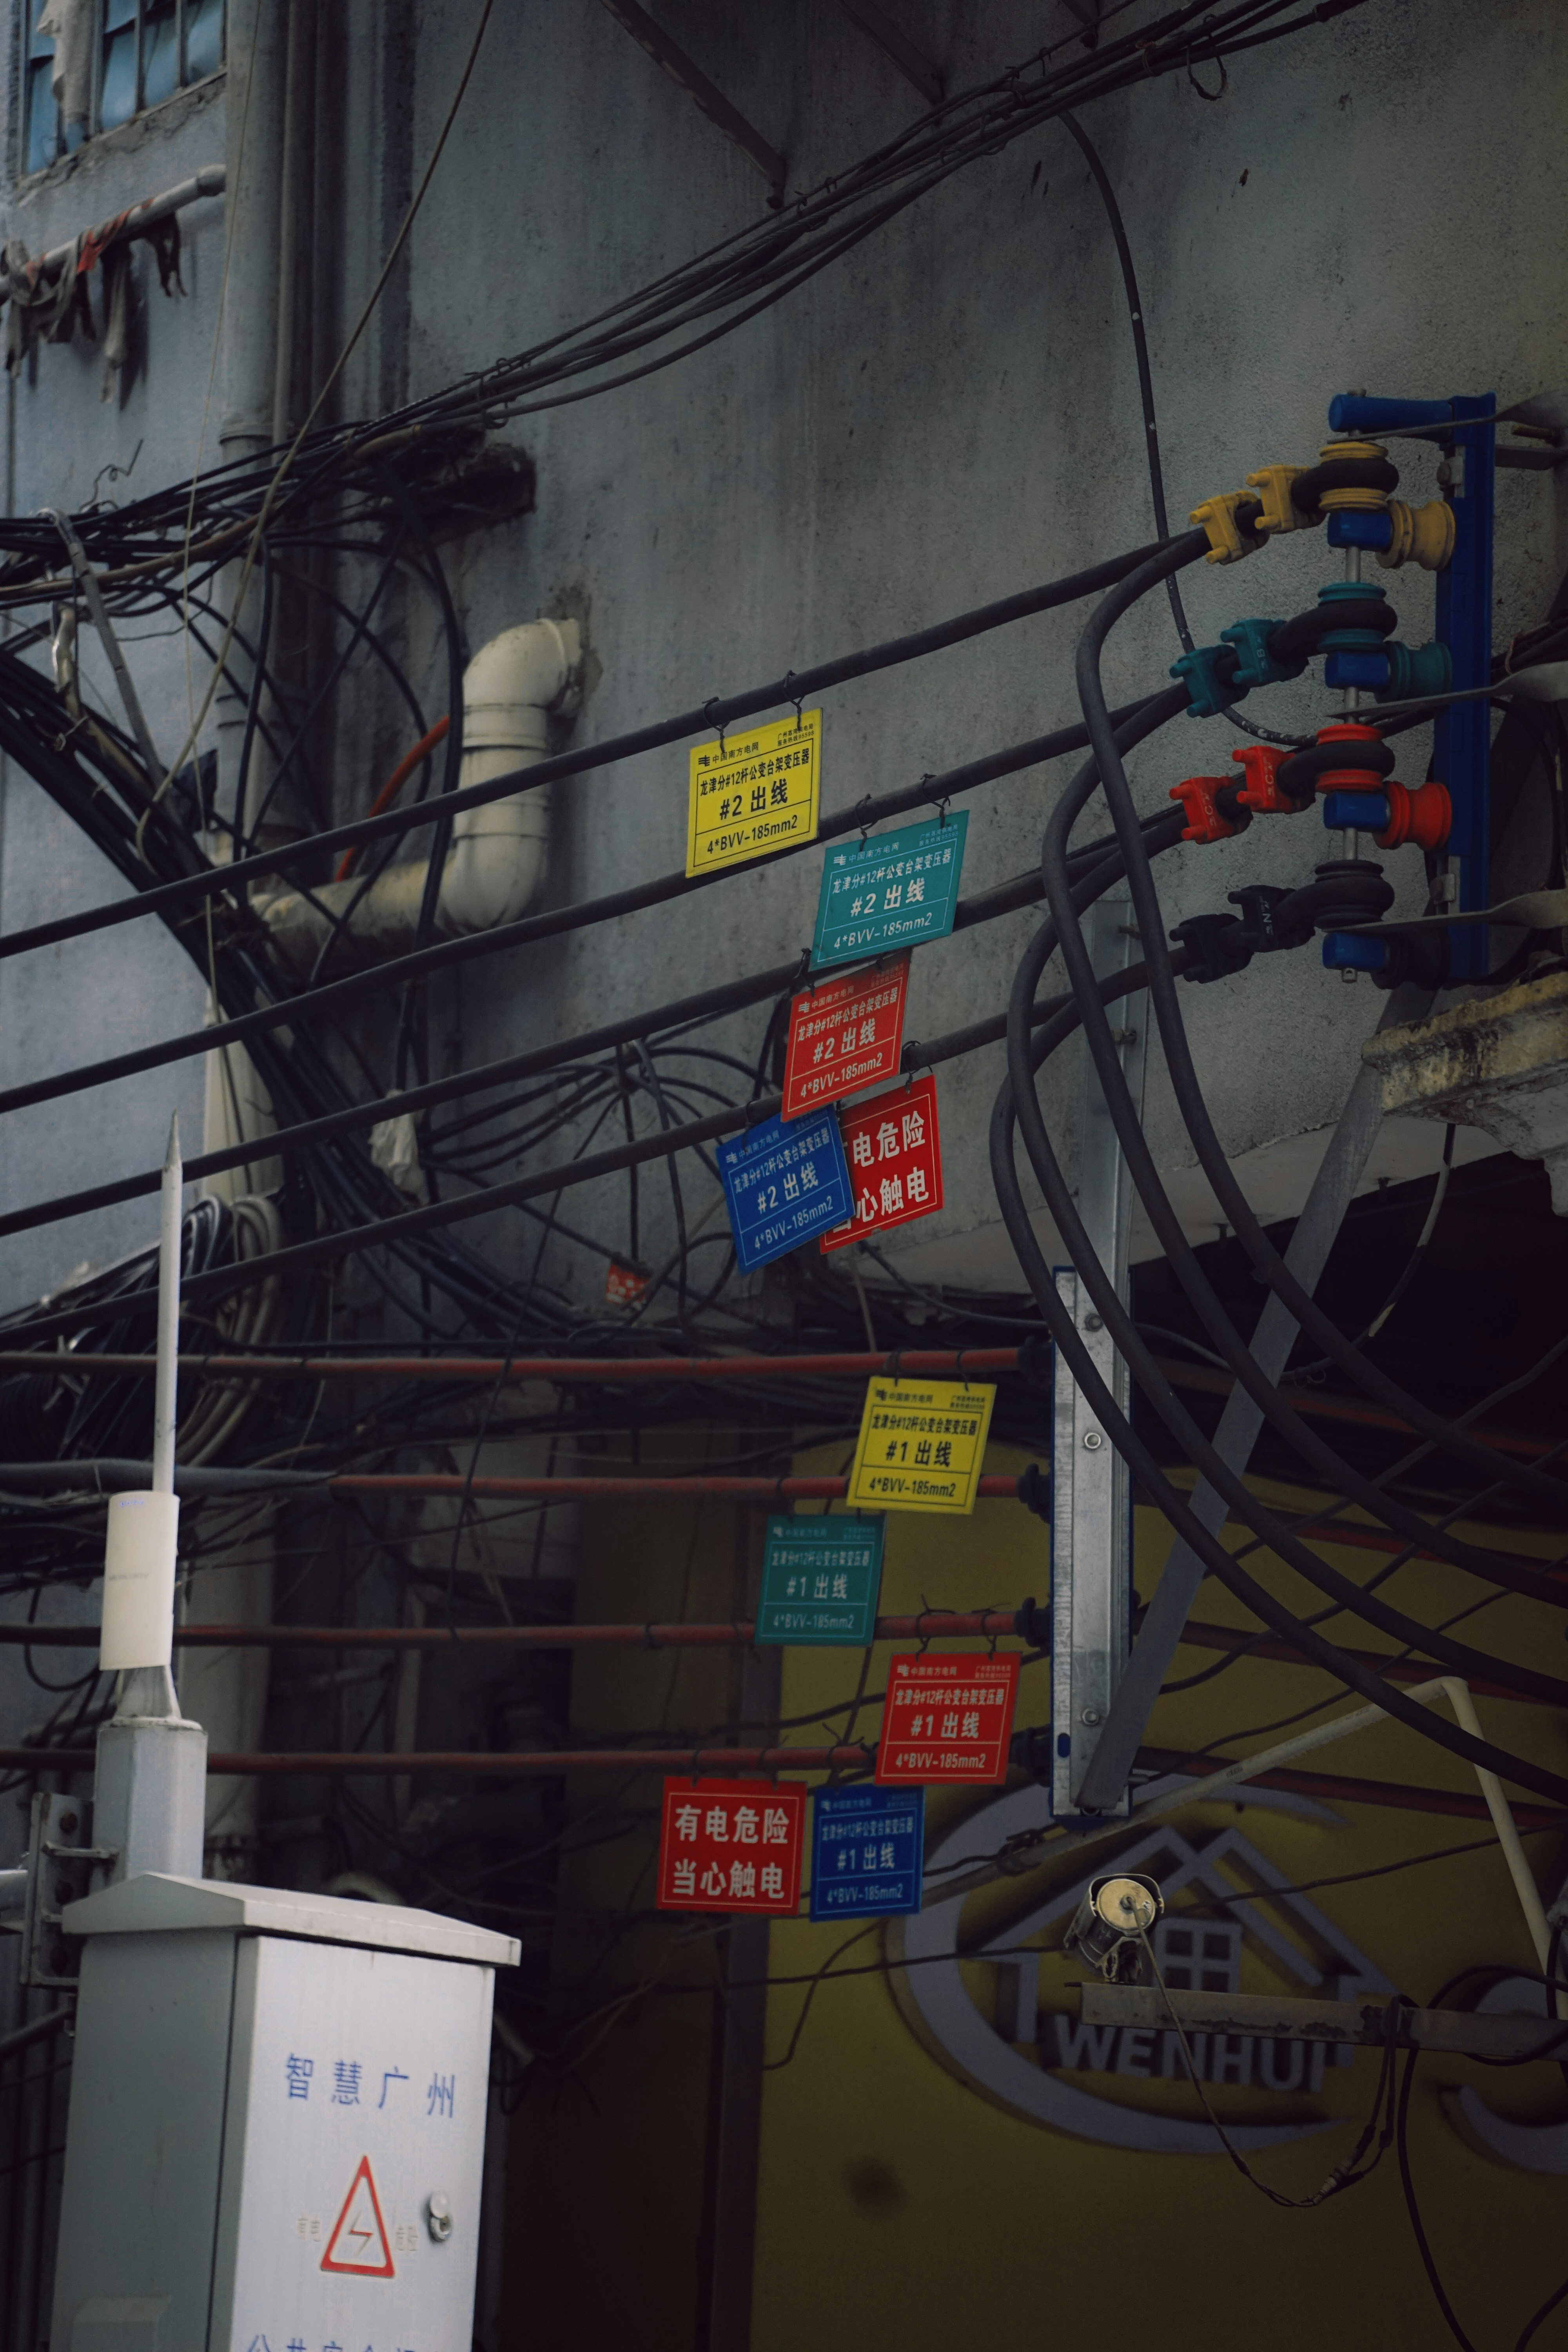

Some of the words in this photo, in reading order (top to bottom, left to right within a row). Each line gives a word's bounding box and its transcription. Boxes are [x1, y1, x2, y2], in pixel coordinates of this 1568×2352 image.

[701, 748, 809, 796] 龙津分#12杆公变台架变压器
[713, 742, 759, 764] 中国南方电网
[720, 795, 742, 820] #2
[751, 778, 788, 812] 出线
[832, 848, 951, 894] 龙津分#12杆公变台架变压器
[849, 842, 900, 862] 中国南方电网
[851, 893, 876, 917] #2
[884, 877, 925, 910] 出线
[798, 986, 898, 1042] 龙津分#12杆公变台架变压器
[811, 985, 854, 1009] 中国南方电网
[813, 1037, 835, 1064] #2
[841, 1018, 875, 1054] 出线
[739, 1129, 779, 1159] 中国南方电网
[844, 1110, 926, 1167] 电危险
[734, 1127, 830, 1194] 龙津分#12杆公变台架变压器
[757, 1185, 779, 1214] #2
[783, 1161, 818, 1201] 出线
[832, 1166, 929, 1233] 心触电
[886, 1441, 908, 1462] #1
[914, 1439, 952, 1467] 出线
[786, 1575, 807, 1597] #1
[814, 1573, 847, 1600] 出线
[911, 1714, 934, 1737] #1
[941, 1711, 980, 1739] 出线
[675, 1804, 790, 1845] 有电危险
[837, 1849, 856, 1870] #1
[863, 1842, 895, 1871] 出线
[672, 1858, 785, 1899] 当心触电
[1054, 2014, 1325, 2093] WENHUI
[286, 2053, 456, 2118] 智慧广州
